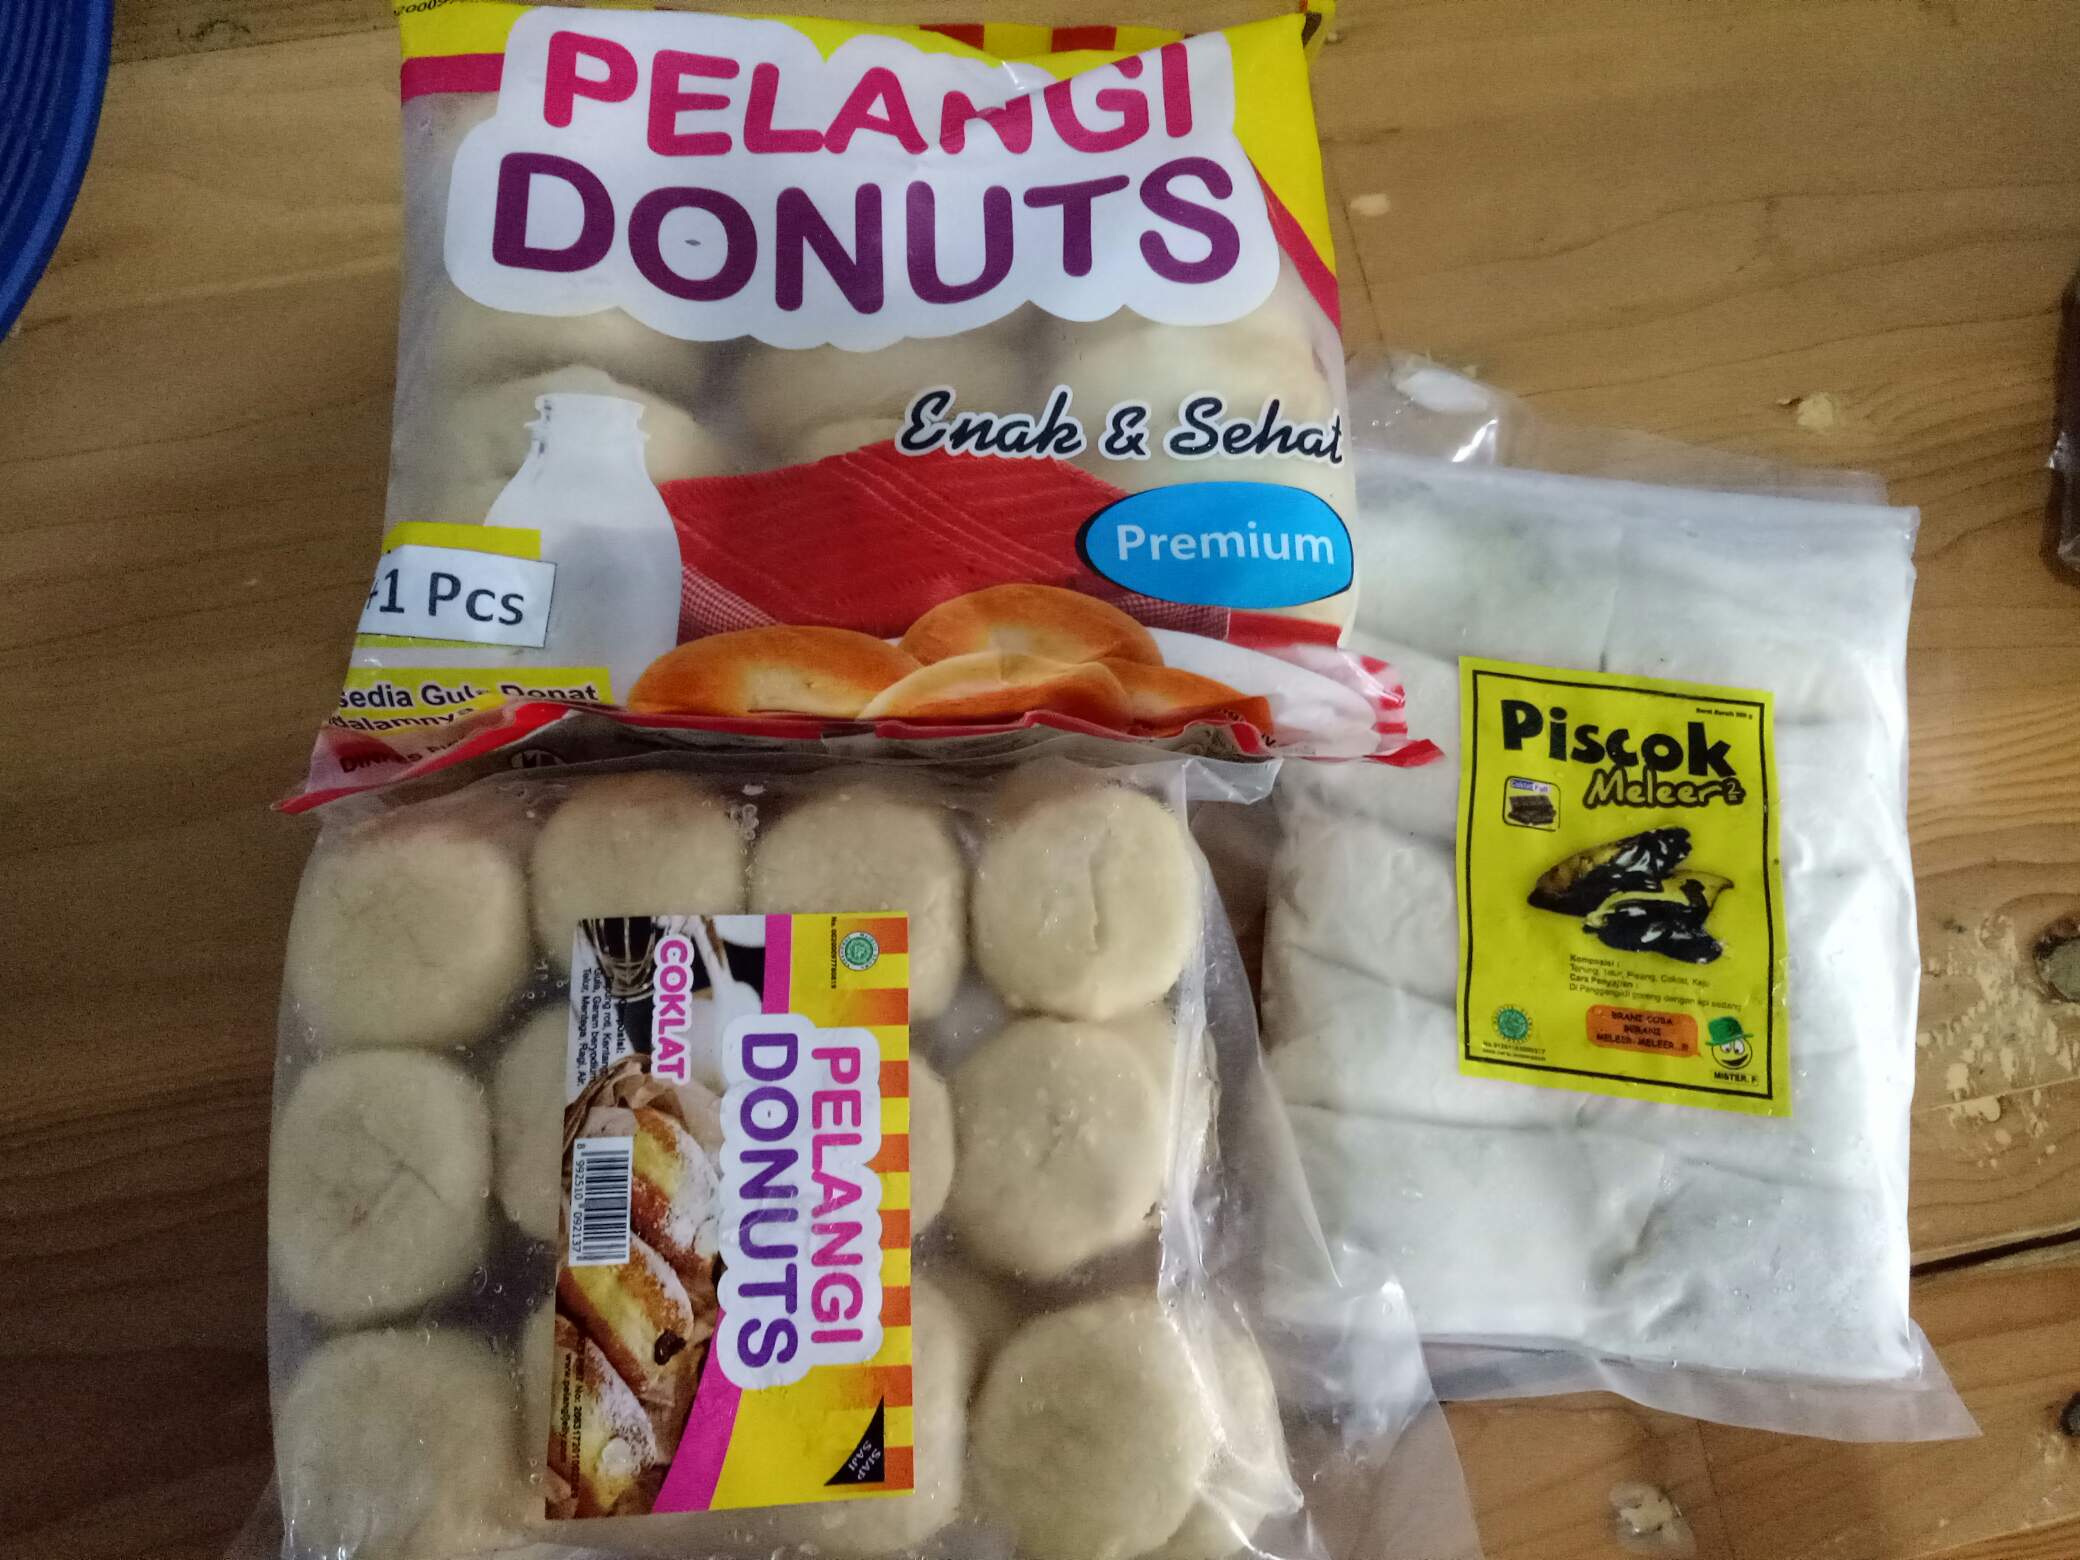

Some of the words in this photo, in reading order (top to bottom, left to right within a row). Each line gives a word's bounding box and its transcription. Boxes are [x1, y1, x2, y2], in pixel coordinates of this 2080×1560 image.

[544, 30, 1194, 157] PELANGI
[491, 151, 1243, 314] DONUTS
[900, 389, 1083, 456] Enak
[1105, 405, 1148, 456] &
[1170, 396, 1343, 463] Sehat
[1116, 521, 1336, 565] Premium
[428, 572, 525, 625] Pcs
[420, 684, 490, 707] Gul
[1501, 699, 1736, 778] Piscok
[591, 996, 601, 1029] Garam
[657, 939, 688, 1080] COKLAT
[574, 1160, 585, 1200] 992510
[737, 1033, 799, 1369] DONUTS
[811, 1047, 864, 1344] PELANGI
[572, 1211, 583, 1253] 092137
